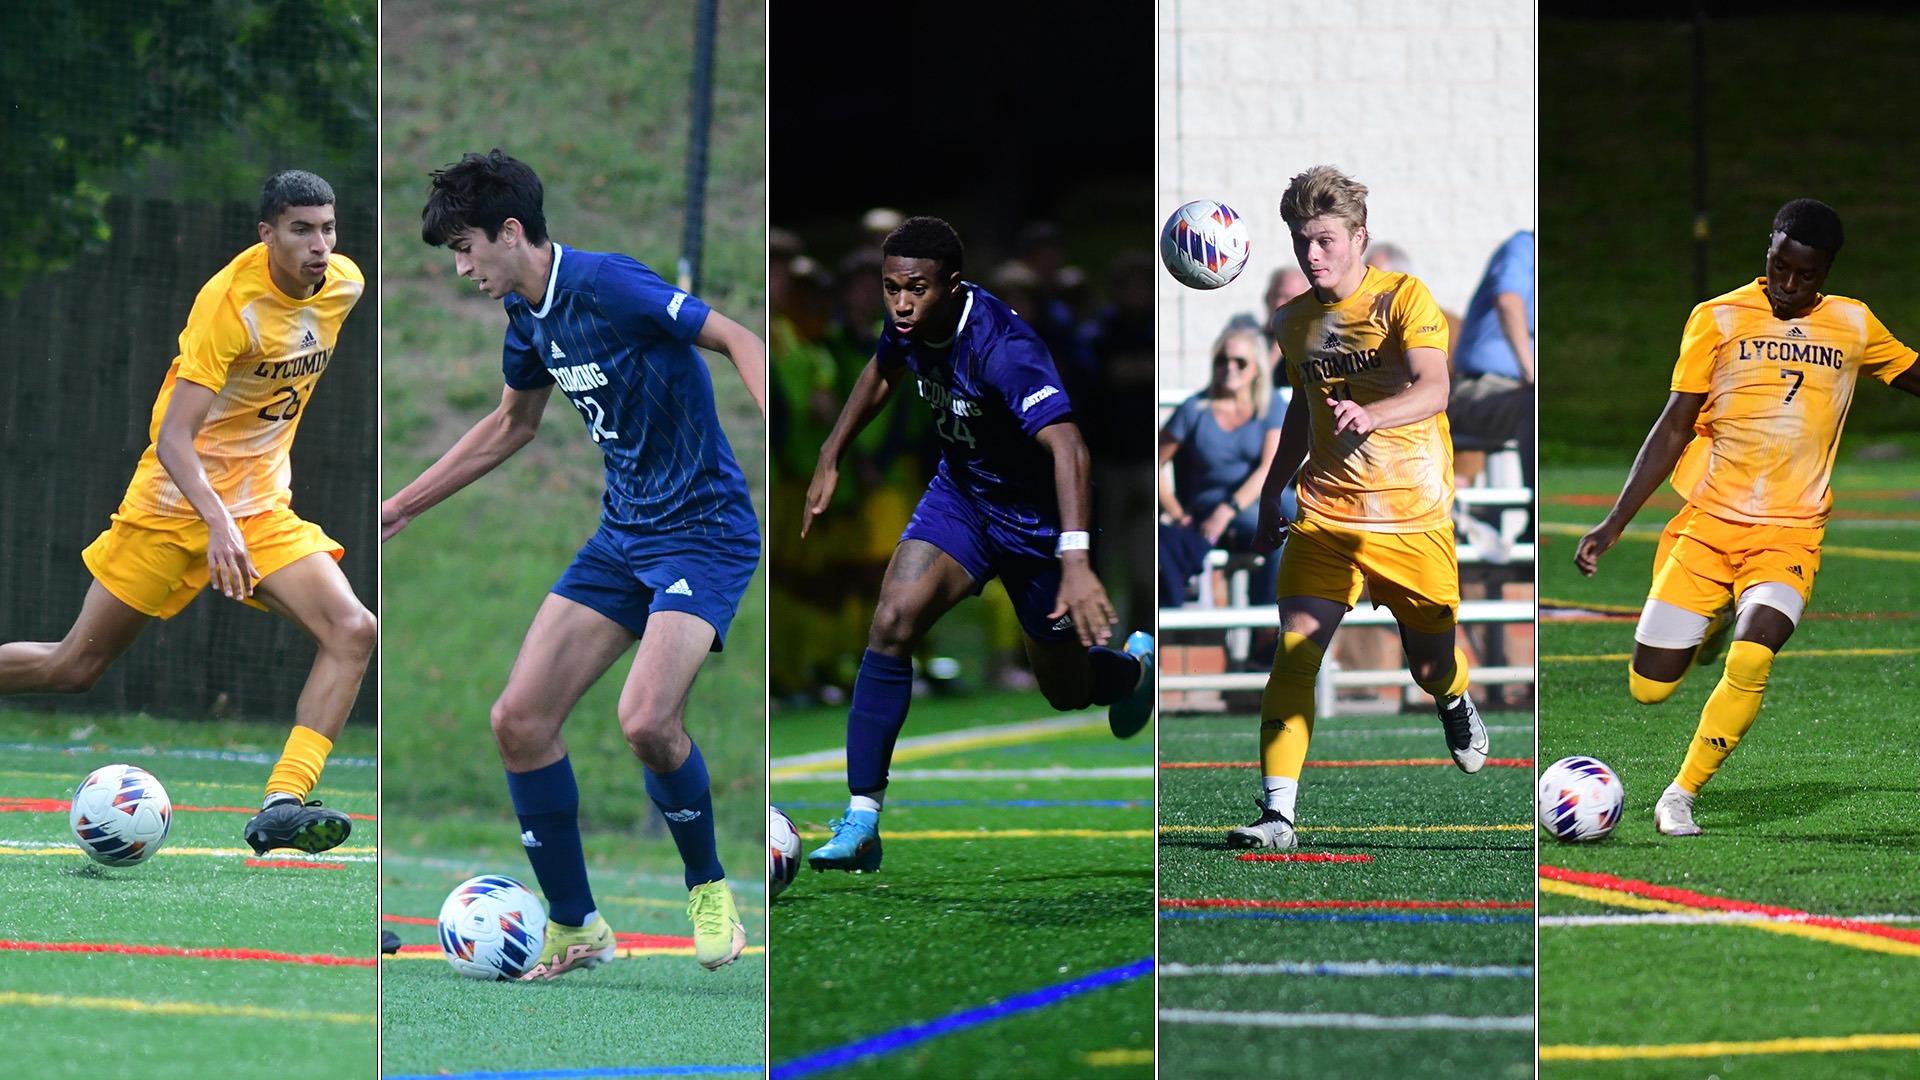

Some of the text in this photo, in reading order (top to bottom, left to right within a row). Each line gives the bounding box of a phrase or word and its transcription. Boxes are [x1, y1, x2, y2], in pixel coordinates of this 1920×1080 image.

[254, 345, 333, 379] LYCOMIN
[1739, 340, 1844, 370] LYCOMING
[1781, 369, 1804, 405] 7
[930, 403, 977, 449] 24
